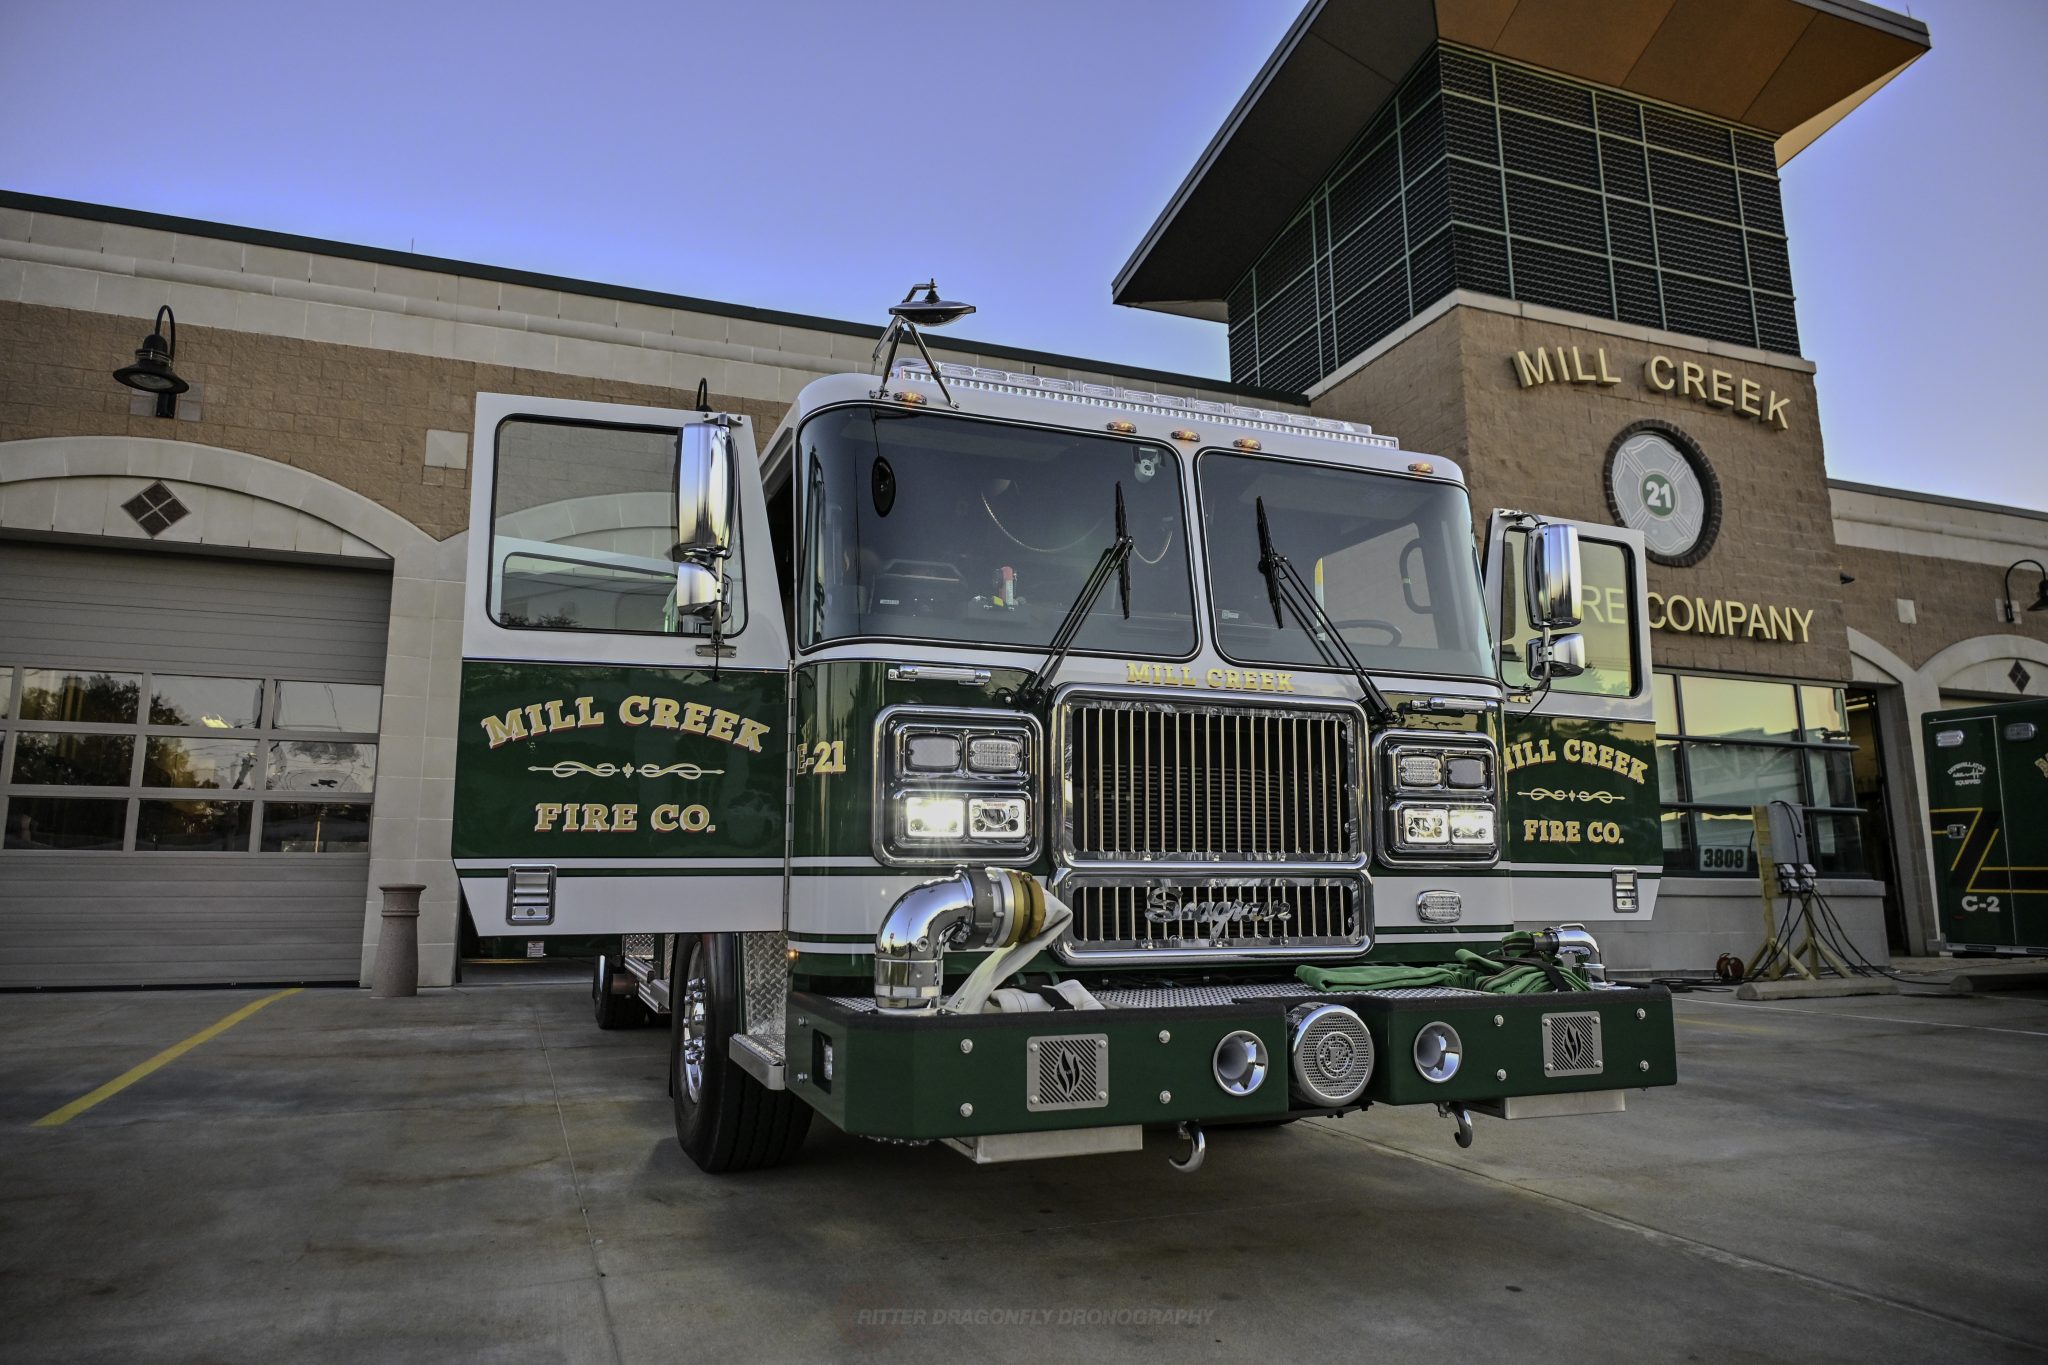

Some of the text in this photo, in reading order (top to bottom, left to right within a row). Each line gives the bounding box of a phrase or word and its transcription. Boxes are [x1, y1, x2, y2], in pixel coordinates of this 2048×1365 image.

[1514, 346, 1791, 430] MILL CREEK
[1645, 481, 1673, 509] 21
[1581, 585, 1814, 642] RE COMPANY
[1126, 663, 1295, 693] MILL CREEK
[480, 695, 771, 752] MILL CREEK
[796, 740, 847, 775] E-21
[1563, 739, 1649, 785] CREEK
[534, 802, 717, 833] FIRE CO.
[1523, 819, 1625, 844] FIRE CO.
[1703, 848, 1744, 868] 3808
[1961, 895, 2001, 913] C-2
